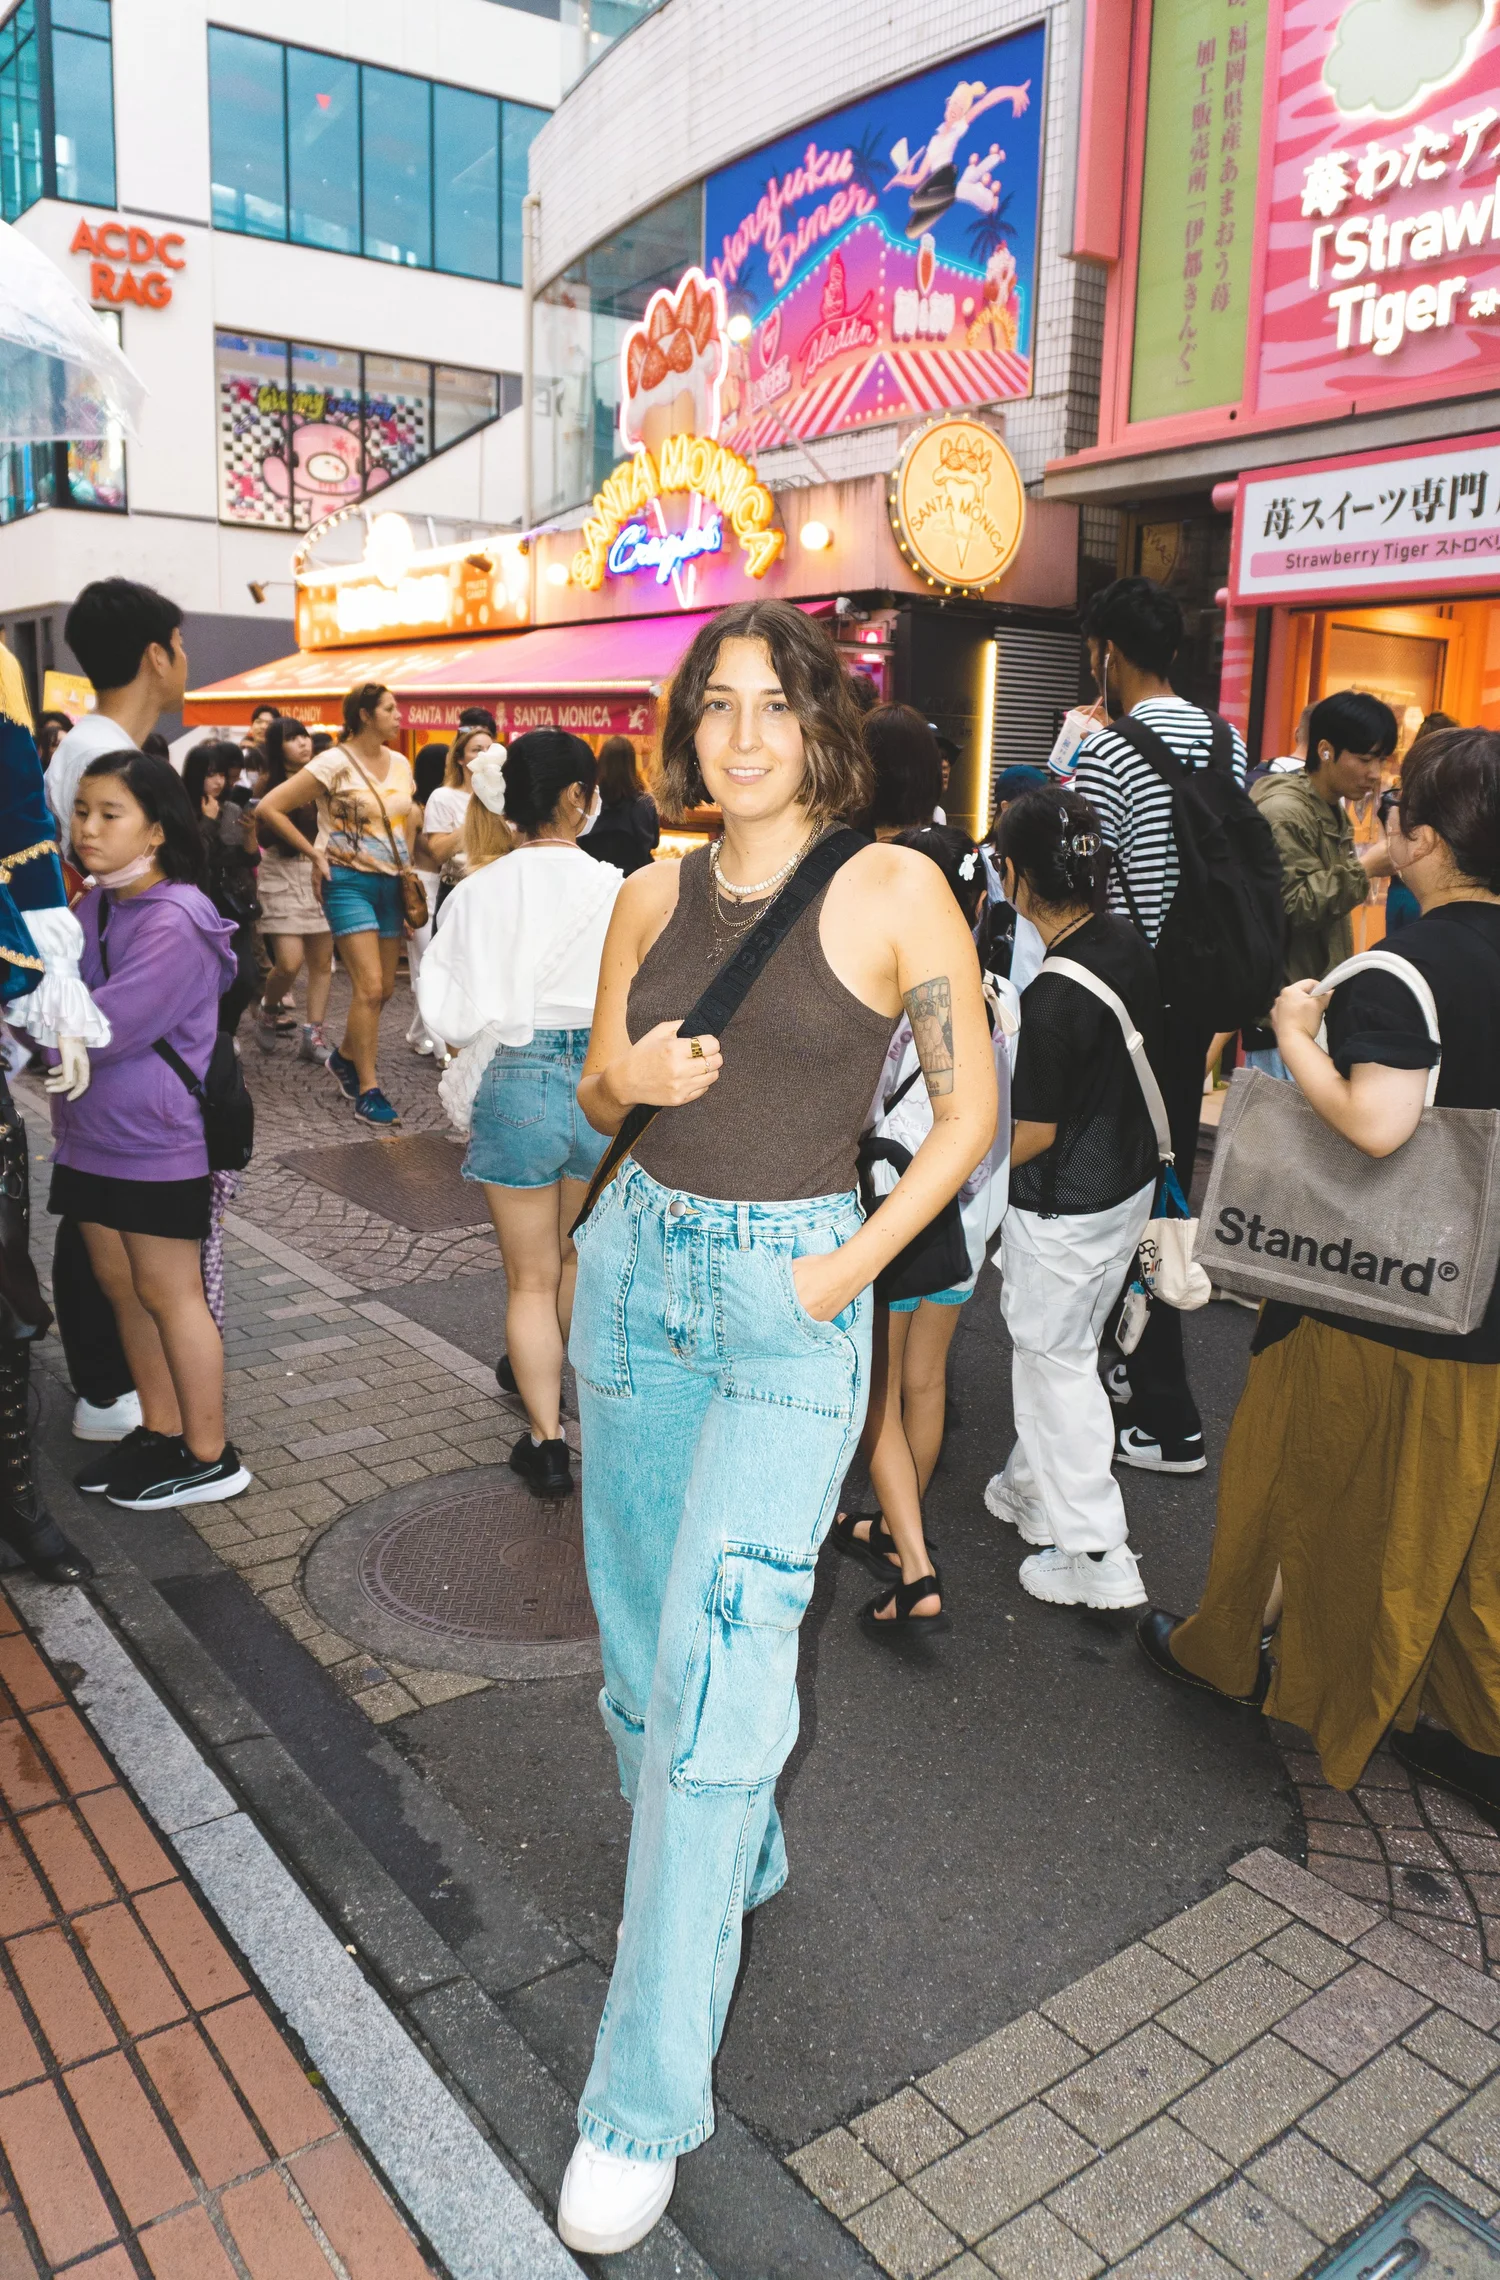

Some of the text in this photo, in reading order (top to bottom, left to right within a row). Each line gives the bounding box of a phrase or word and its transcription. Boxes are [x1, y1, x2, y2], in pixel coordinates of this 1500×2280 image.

[1301, 106, 1500, 218] 苺わたア
[69, 215, 187, 272] ACDC
[711, 142, 854, 286] Harajuku
[767, 183, 878, 292] Diner
[89, 260, 173, 310] RAG
[1327, 275, 1468, 357] Tiger
[802, 318, 876, 388] Aladdin
[571, 432, 785, 592] SANTA MONICA
[911, 495, 956, 532] SANTA
[958, 498, 1006, 559] MONICA
[1263, 470, 1500, 541] 苺スイーツ専門
[1285, 543, 1380, 570] Strawberry
[1384, 542, 1430, 563] Tiger
[292, 705, 321, 722] CANDY
[408, 705, 442, 725] SANTA
[513, 705, 612, 728] SANTA MONICA
